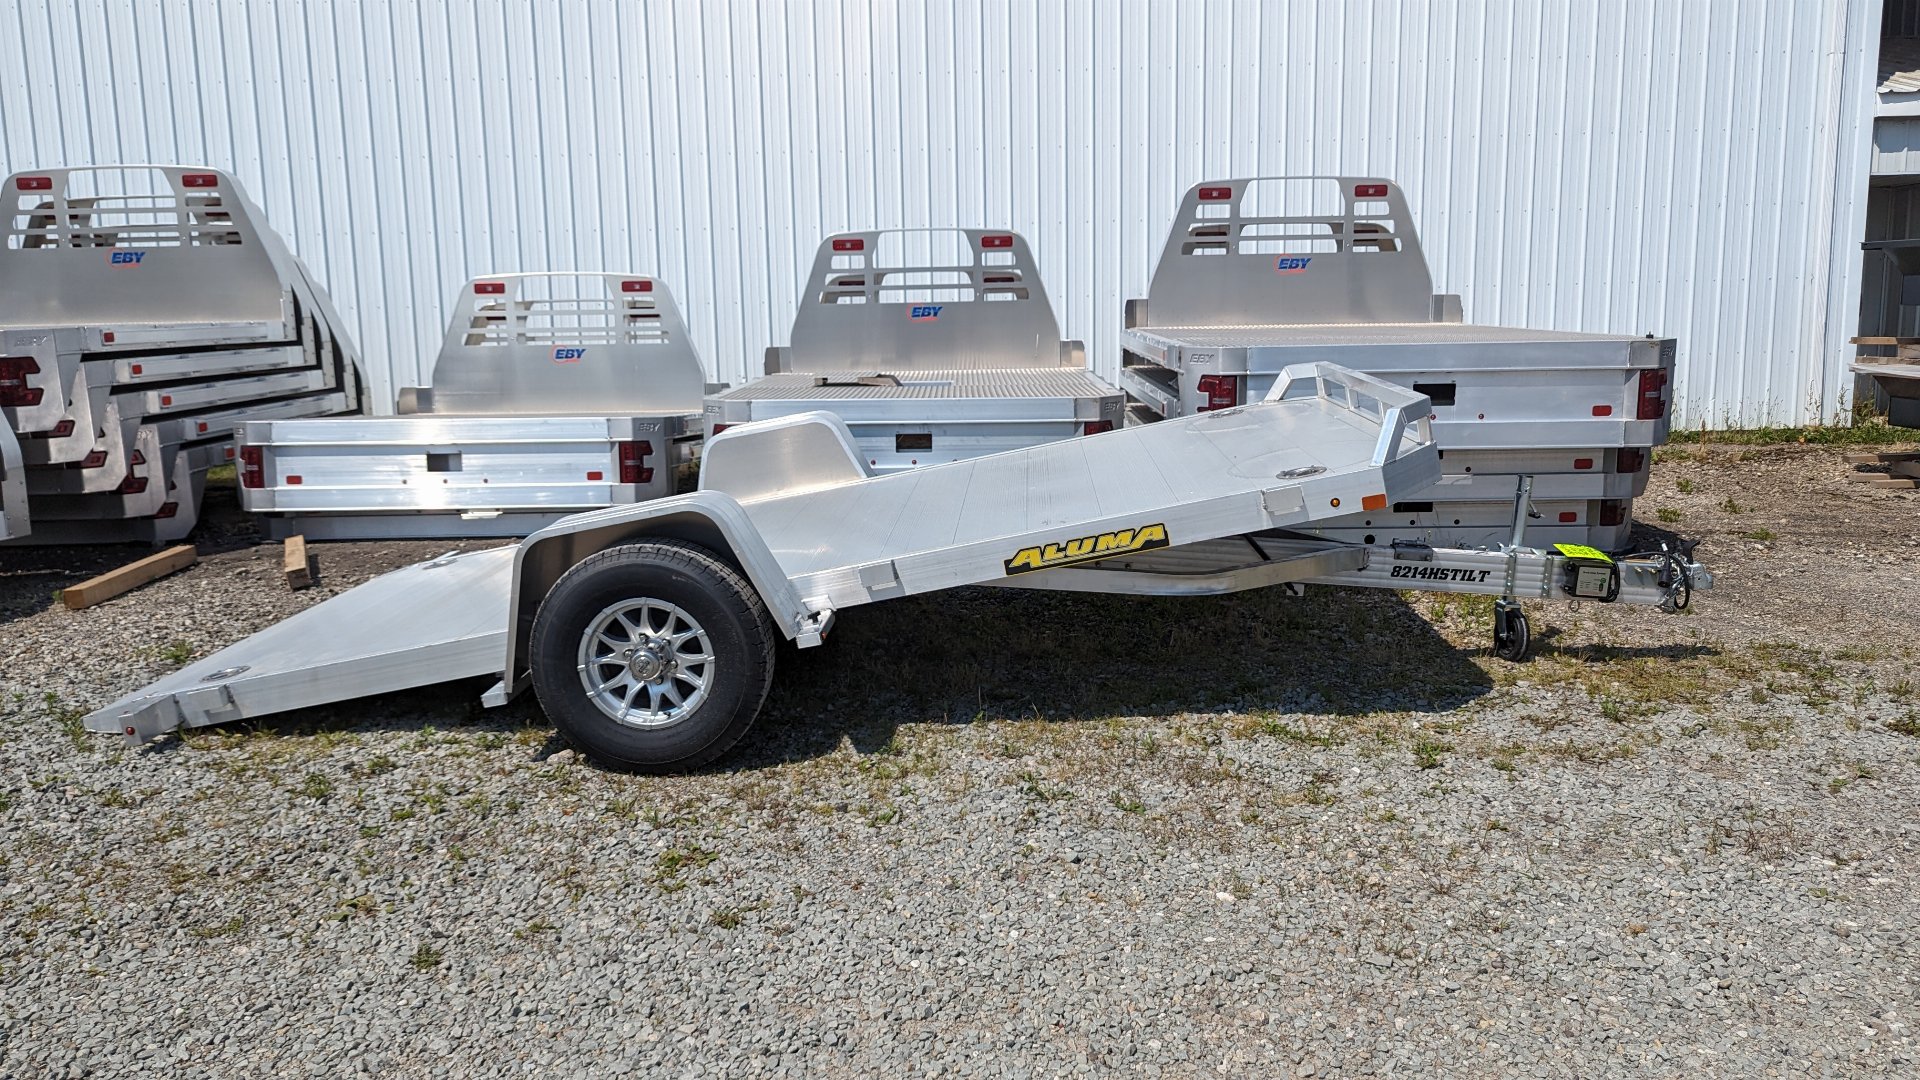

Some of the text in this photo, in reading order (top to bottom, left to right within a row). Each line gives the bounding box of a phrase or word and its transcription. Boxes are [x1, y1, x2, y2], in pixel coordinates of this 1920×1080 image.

[111, 252, 146, 265] EBY
[1278, 257, 1312, 270] EBY
[910, 306, 944, 318] EBY
[555, 348, 587, 360] EBY
[1189, 353, 1215, 365] EBY
[1007, 523, 1168, 569] ALUMA
[1390, 565, 1491, 582] 8214HSTILT
